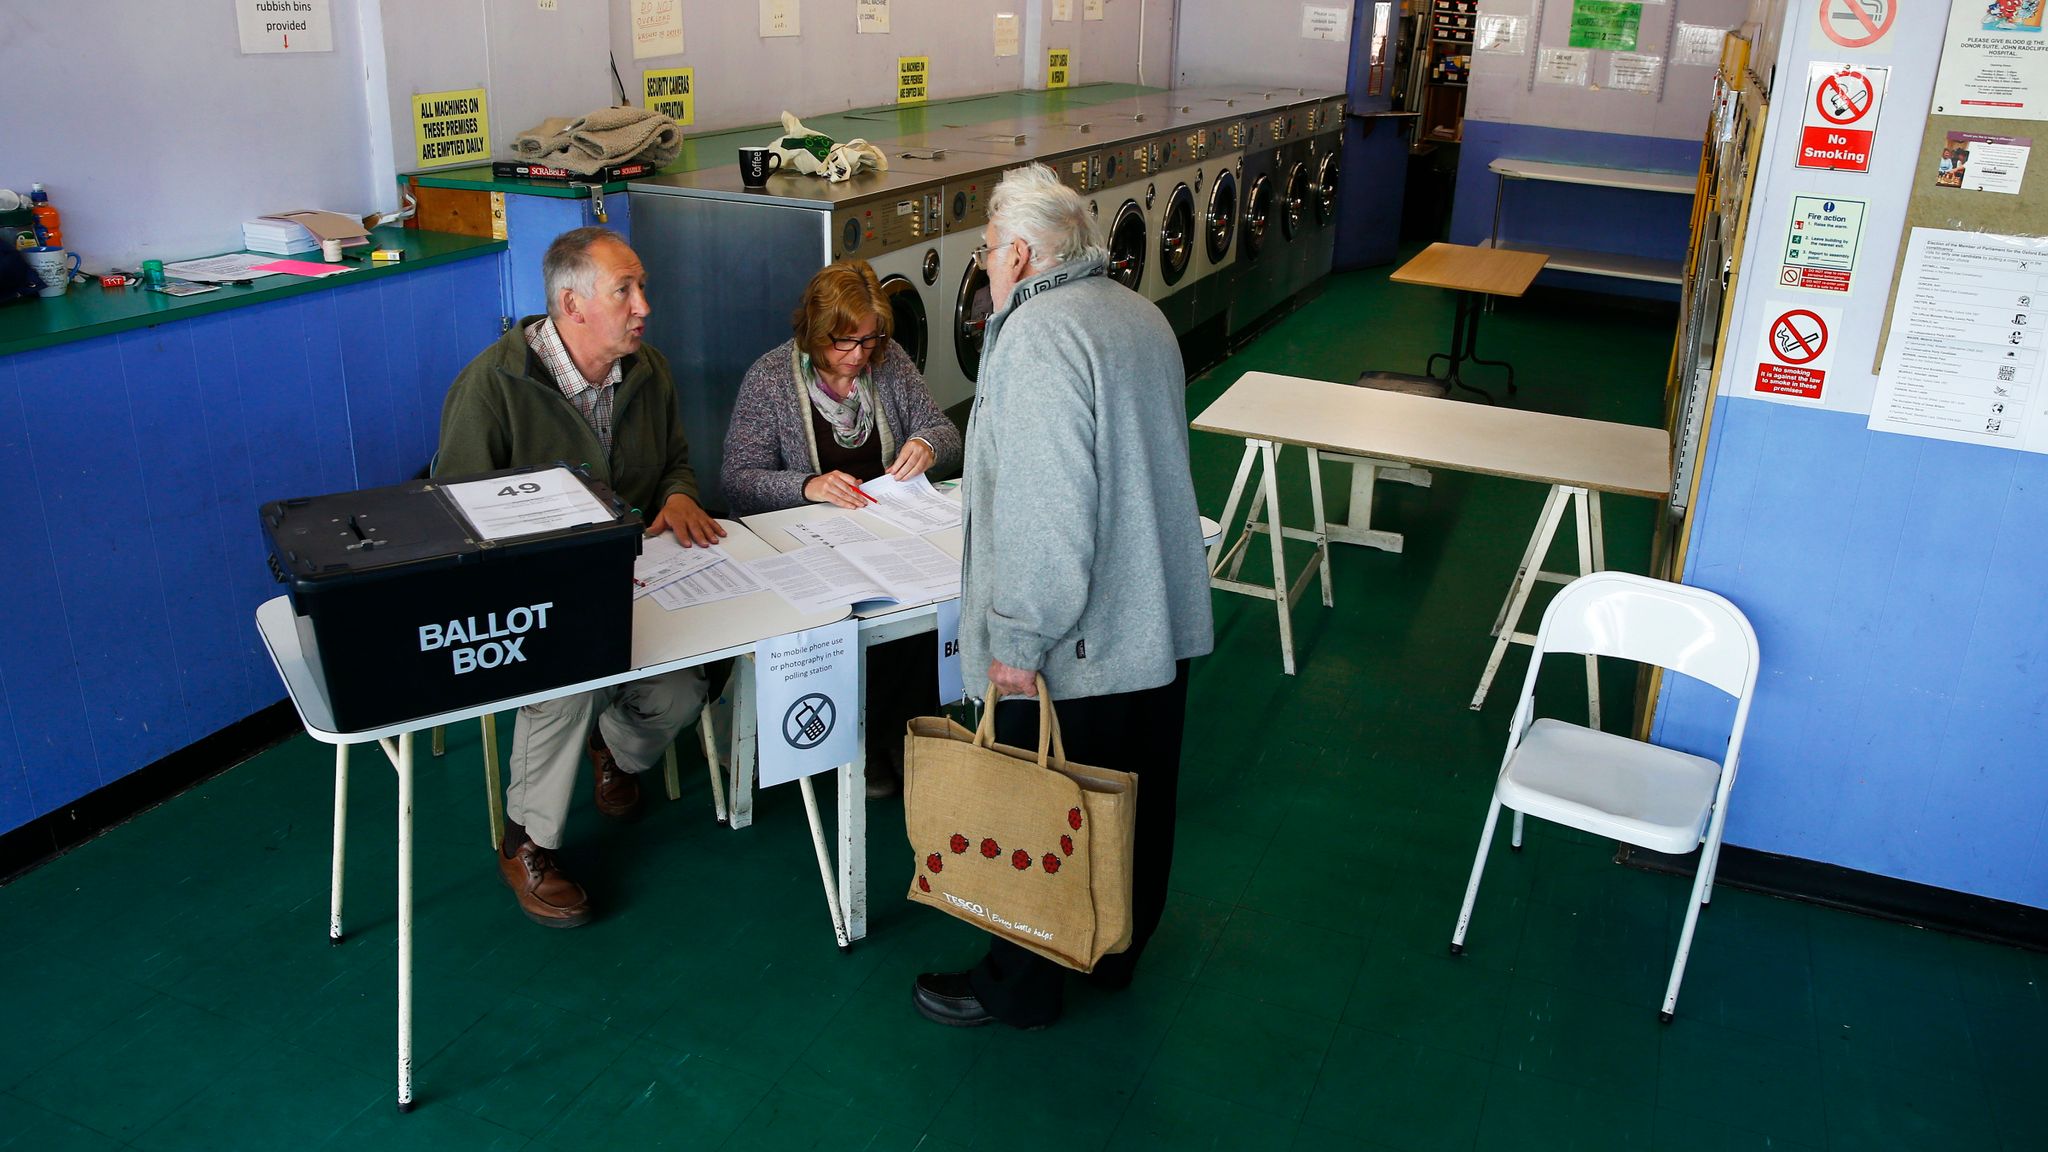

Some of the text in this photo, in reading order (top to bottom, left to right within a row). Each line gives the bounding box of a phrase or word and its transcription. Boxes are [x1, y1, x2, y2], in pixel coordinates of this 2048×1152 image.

[256, 1, 311, 11] rubbish bins
[266, 20, 306, 32] provided
[647, 75, 689, 97] SECURITY CAMERAS
[422, 98, 479, 119] ALL MACHINES ON
[660, 101, 684, 120] OPERATION
[423, 118, 478, 139] THESE PREMISES
[423, 137, 484, 160] ARE EMPTIED DAILY
[1828, 134, 1847, 145] No
[752, 151, 762, 178] Coffee
[1805, 147, 1865, 164] Smoking
[531, 166, 566, 177] SCRABBLE
[1773, 373, 1797, 381] against
[1784, 368, 1811, 377] smoking
[1773, 386, 1803, 394] premises
[498, 483, 541, 497] 49
[419, 602, 553, 651] BALLOT
[452, 636, 527, 675] BOX
[783, 647, 808, 657] mobile
[809, 641, 830, 652] phone
[780, 655, 825, 671] photography
[833, 649, 844, 657] the
[784, 664, 833, 682] polling station
[942, 892, 984, 915] TESCO
[992, 914, 1012, 929] Every
[1034, 929, 1054, 940] helps
